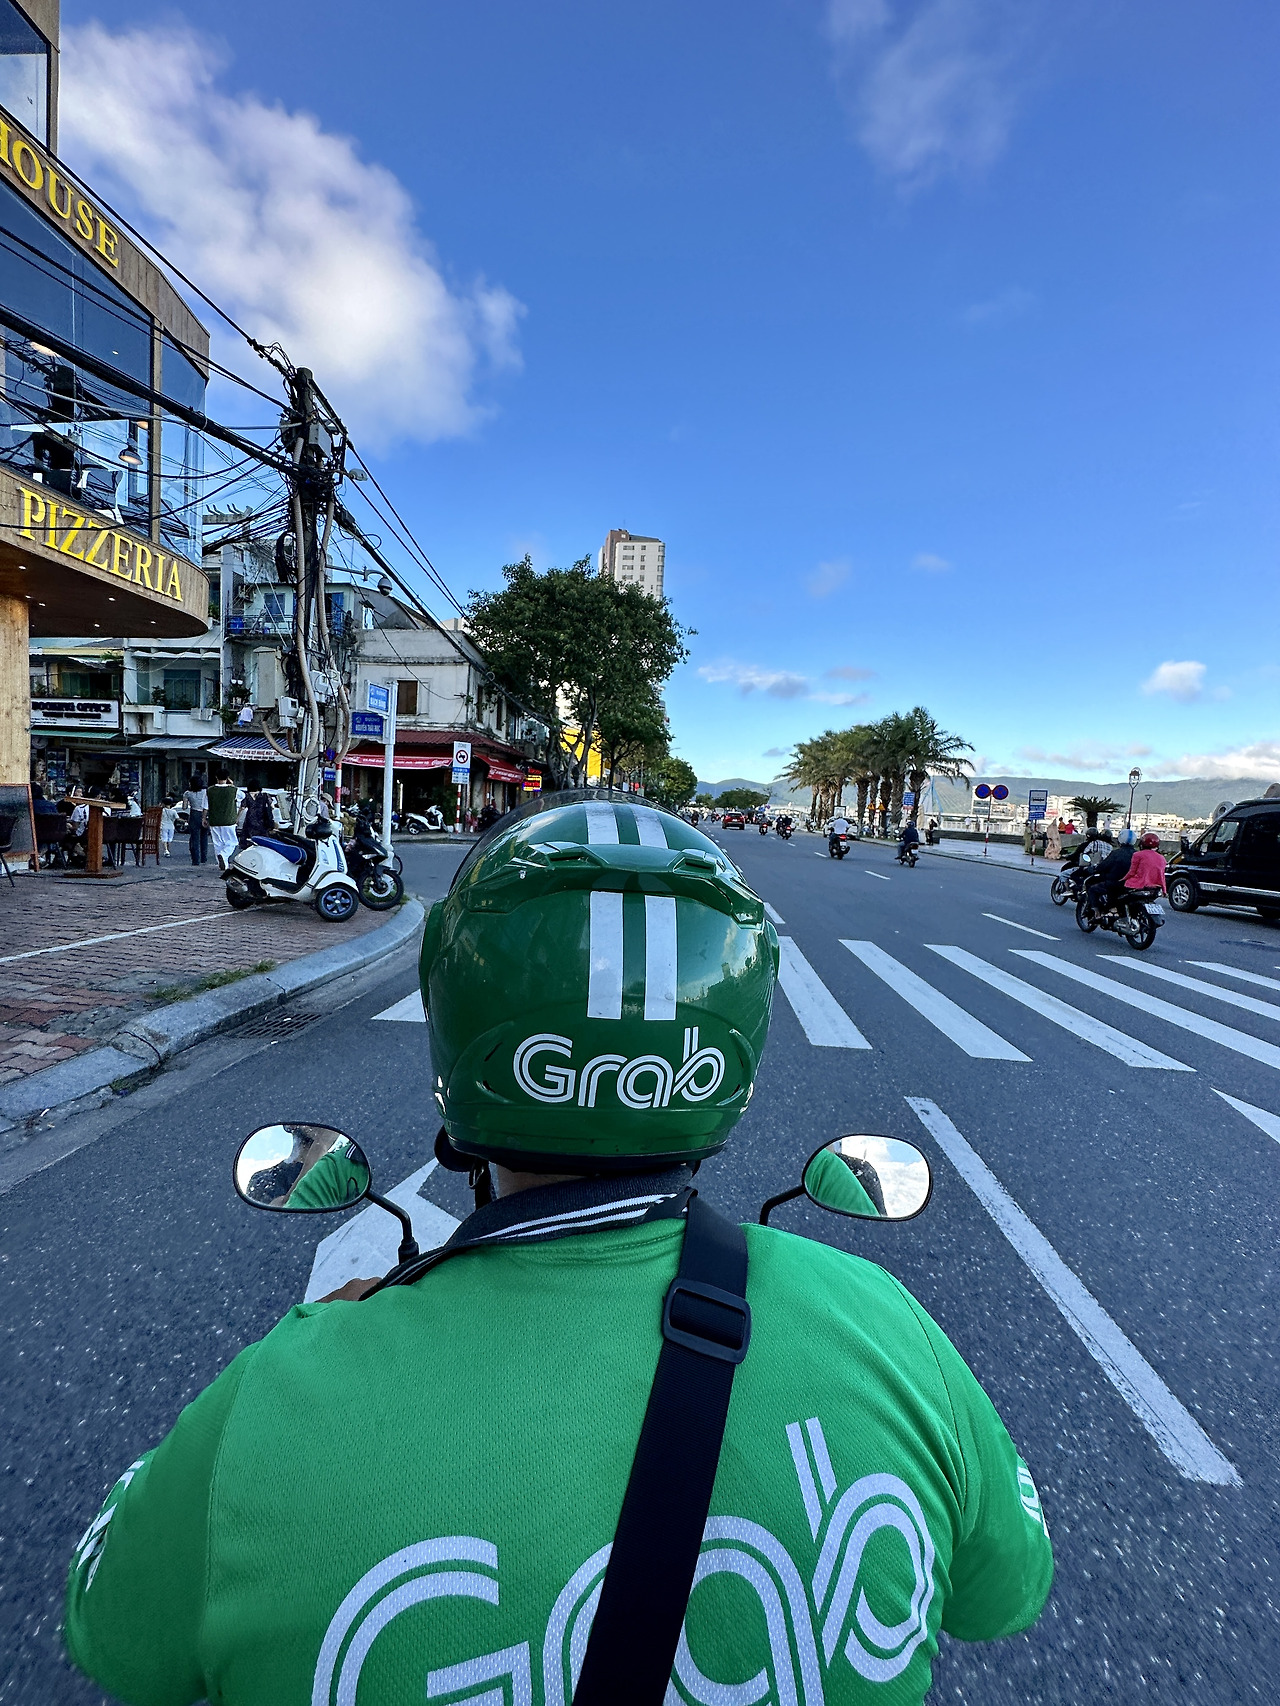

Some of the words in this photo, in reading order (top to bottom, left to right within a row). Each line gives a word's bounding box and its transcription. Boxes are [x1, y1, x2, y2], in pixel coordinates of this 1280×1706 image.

[17, 486, 183, 602] PIZZERIA
[76, 702, 112, 713] OFFICE
[513, 1026, 725, 1109] Grab
